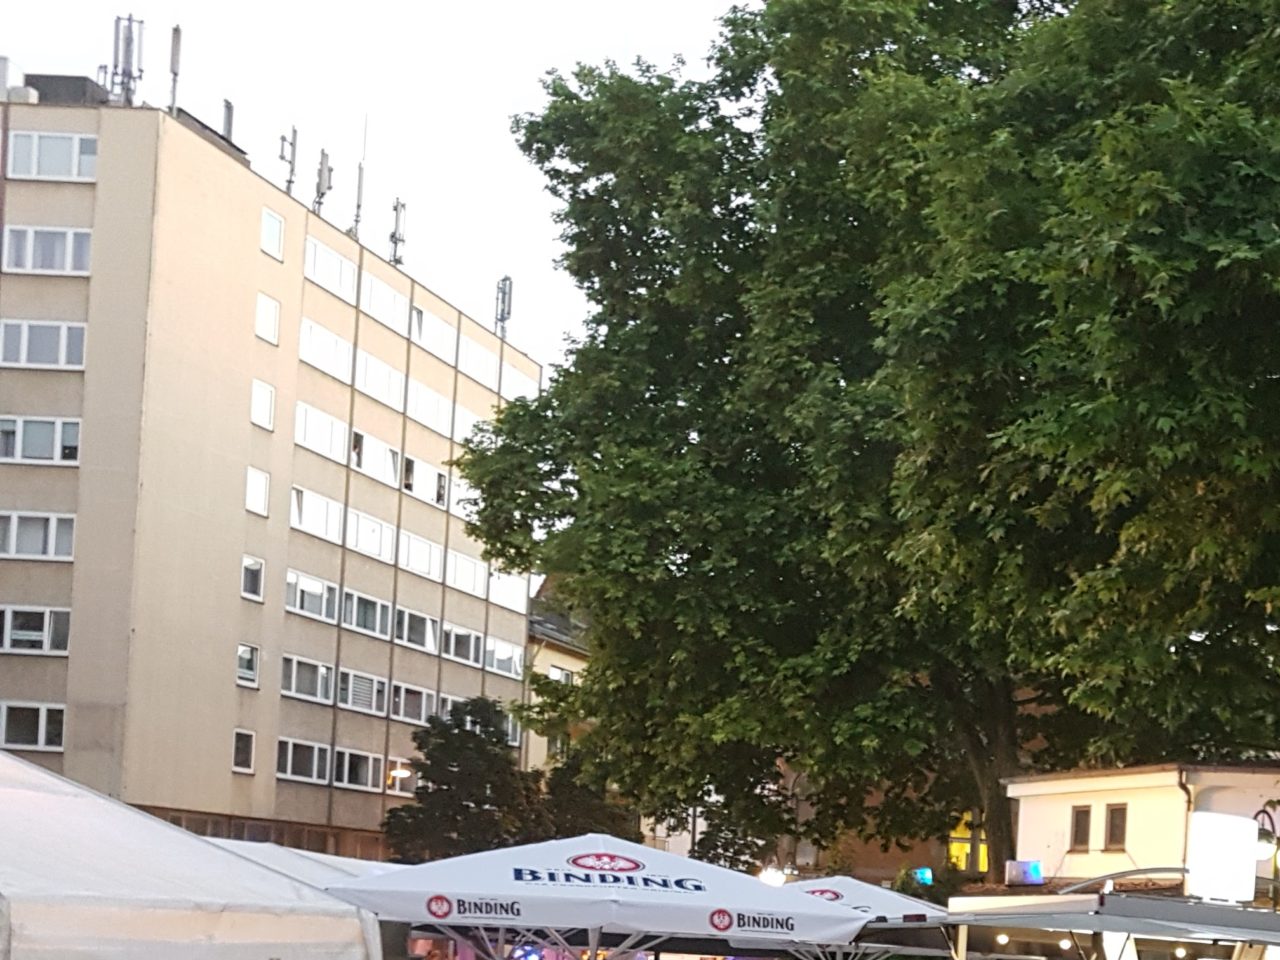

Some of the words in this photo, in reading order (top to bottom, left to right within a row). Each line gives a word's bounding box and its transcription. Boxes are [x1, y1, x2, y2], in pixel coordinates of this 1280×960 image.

[513, 867, 706, 892] BINDING
[456, 898, 521, 917] BINDING
[736, 912, 795, 932] BINDING
